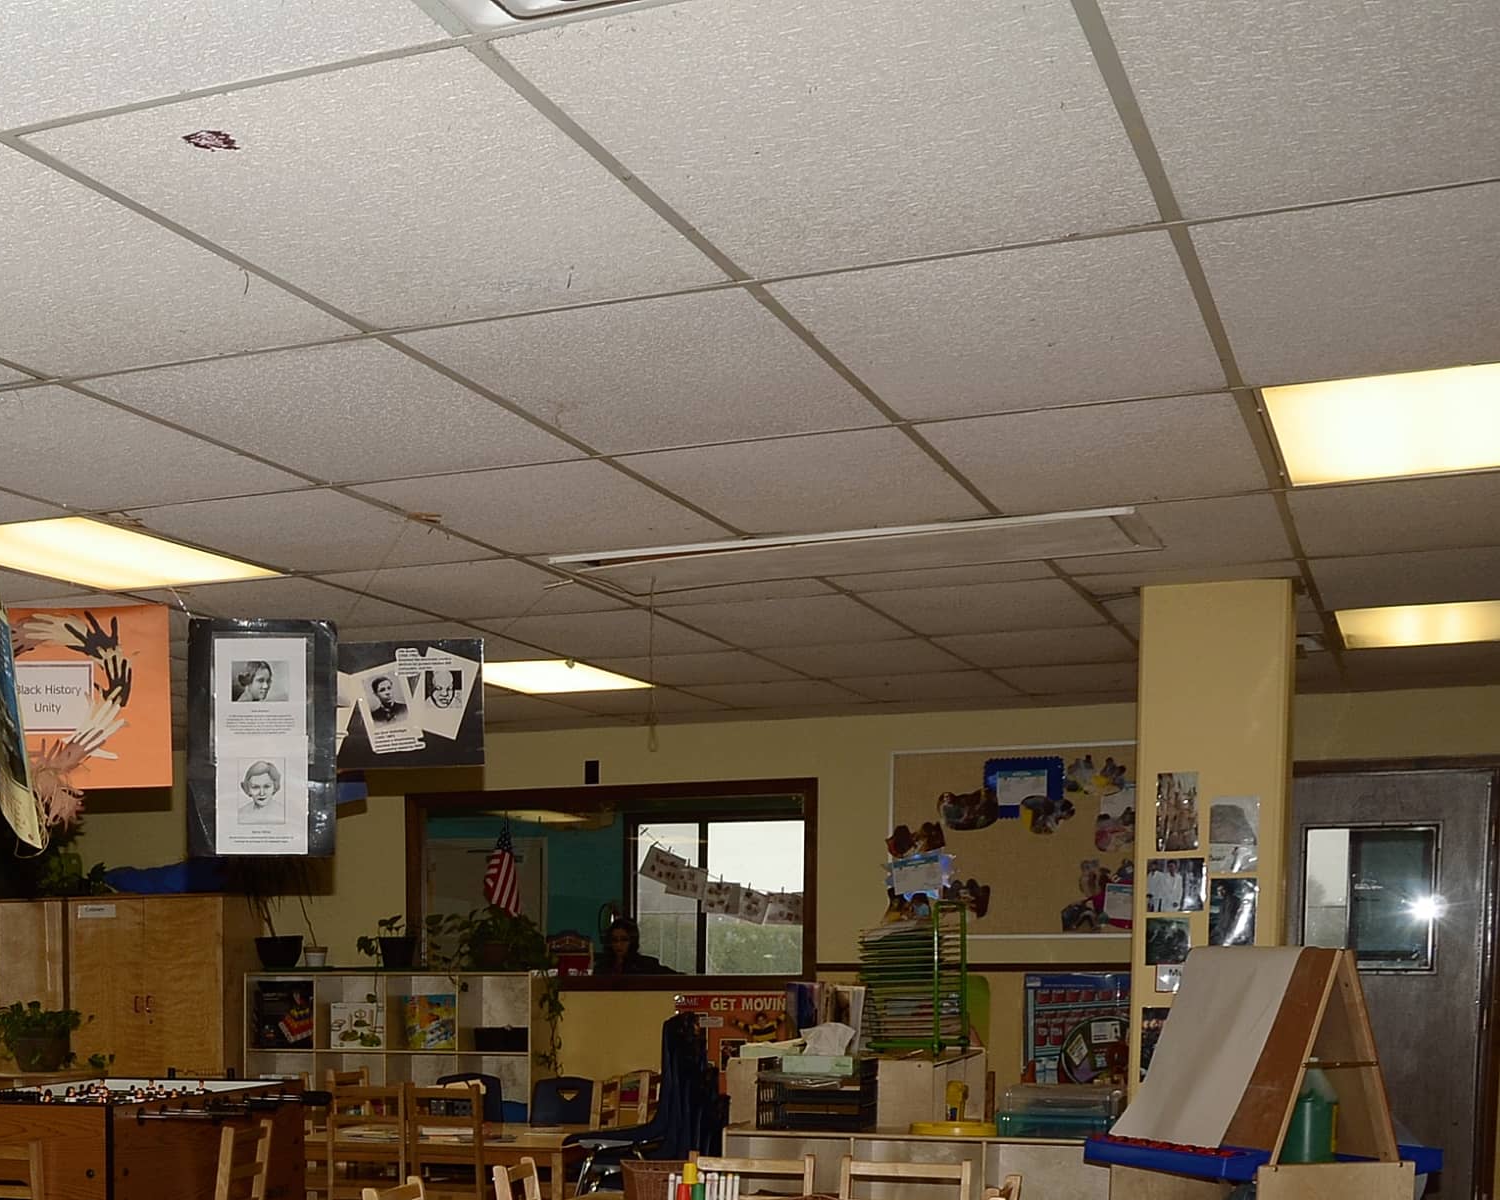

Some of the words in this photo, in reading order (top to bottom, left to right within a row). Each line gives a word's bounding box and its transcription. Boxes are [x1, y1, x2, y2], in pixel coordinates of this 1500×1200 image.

[45, 683, 81, 698] History
[33, 701, 61, 715] Unity
[710, 997, 737, 1011] GET
